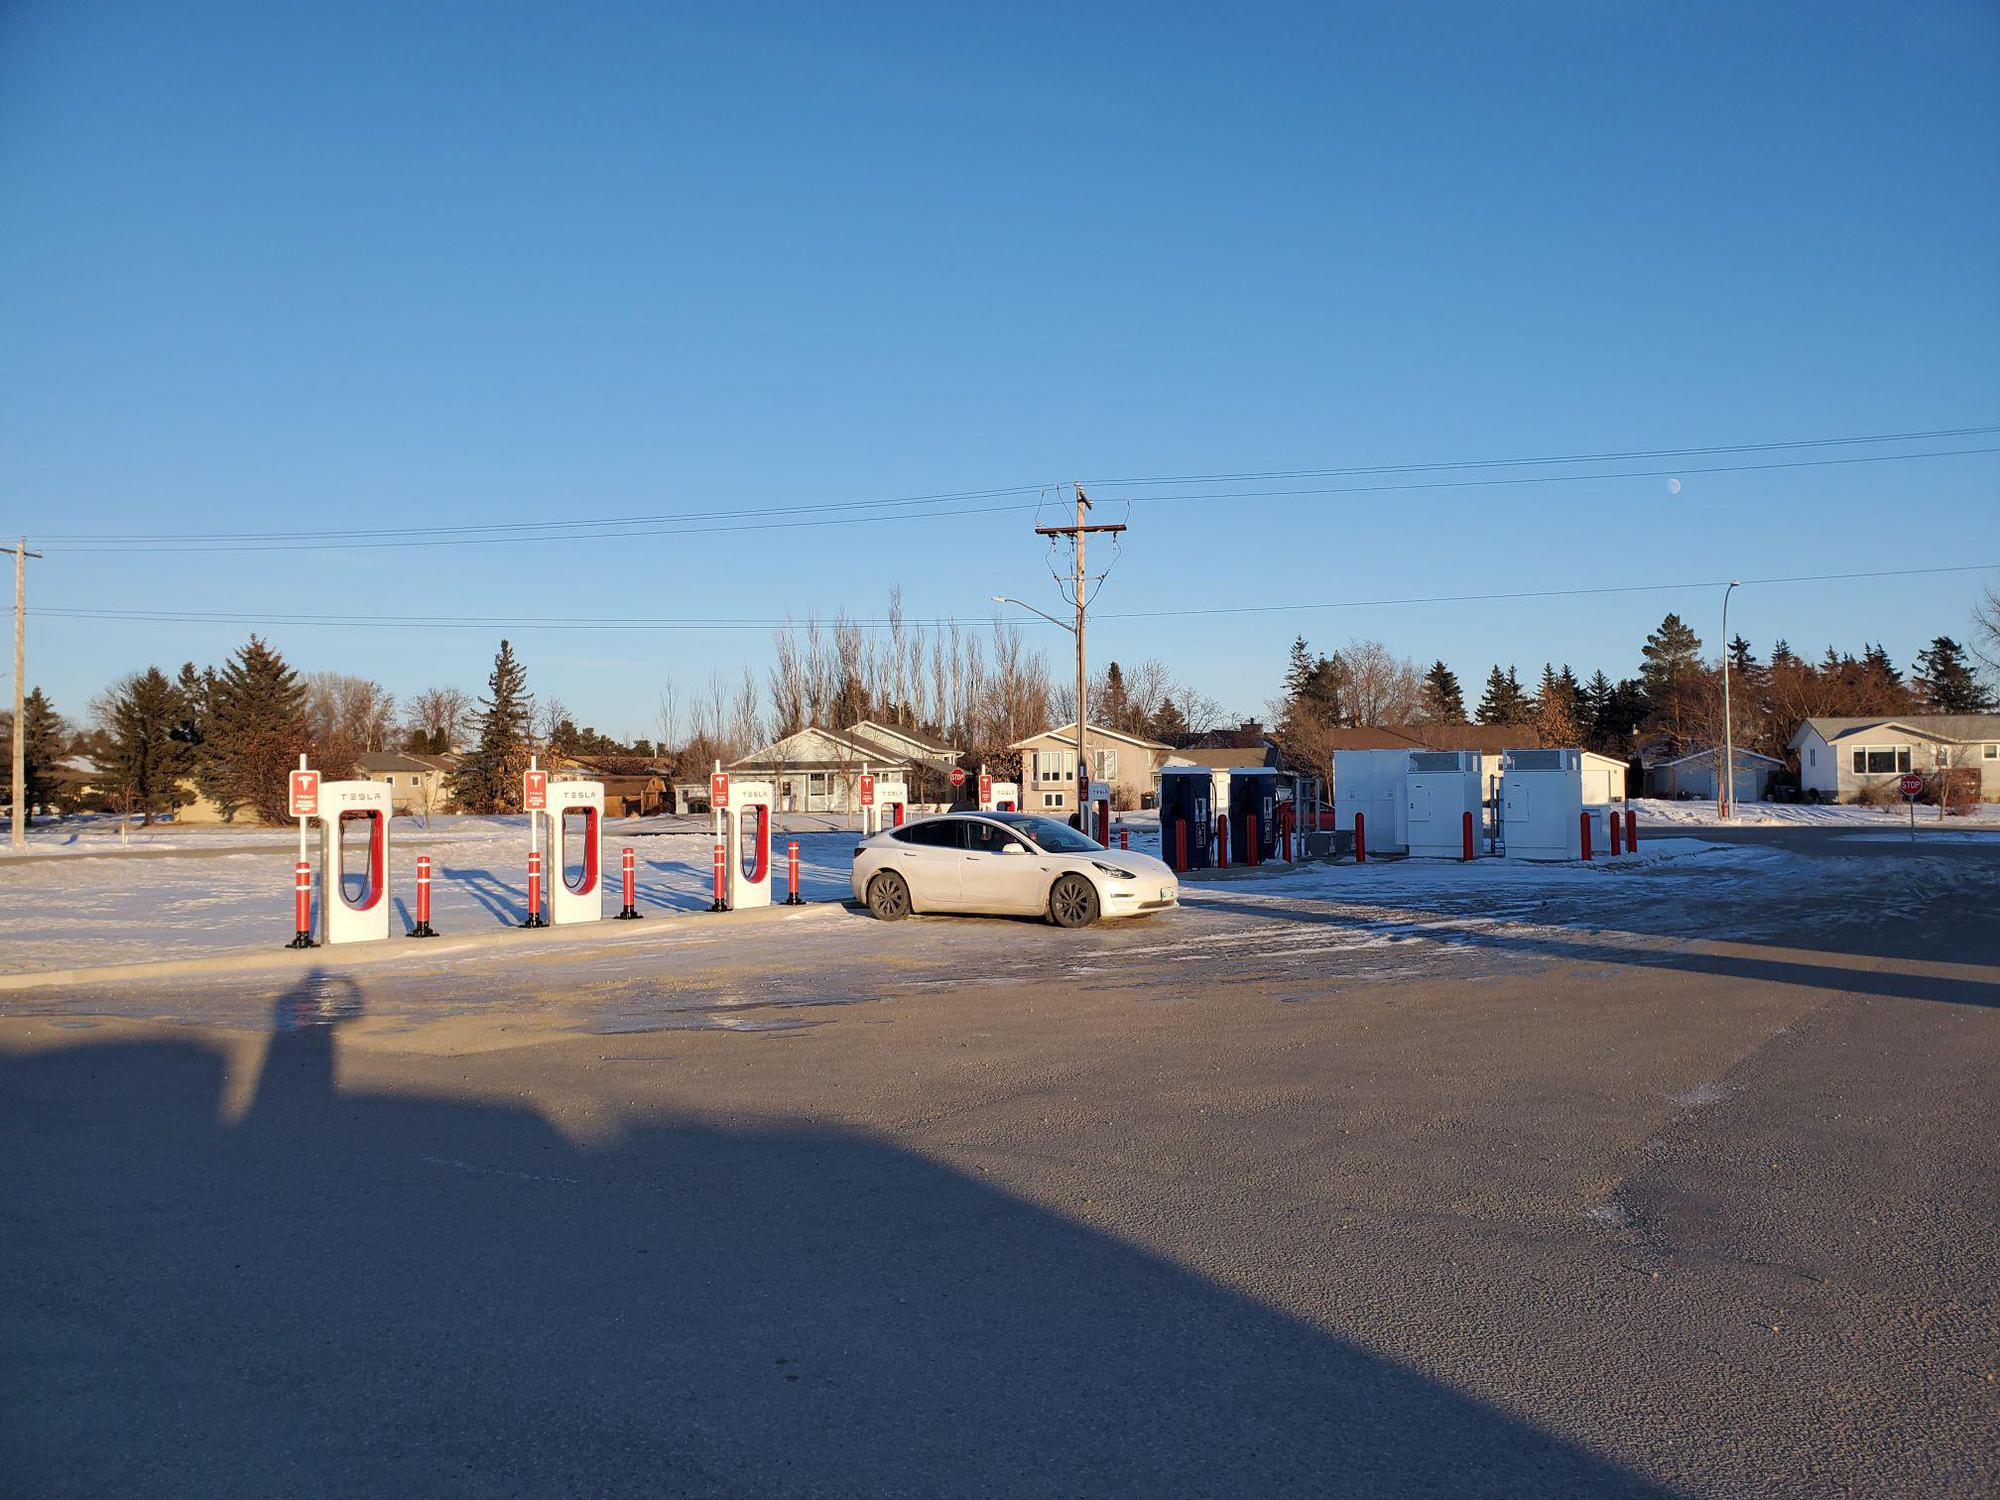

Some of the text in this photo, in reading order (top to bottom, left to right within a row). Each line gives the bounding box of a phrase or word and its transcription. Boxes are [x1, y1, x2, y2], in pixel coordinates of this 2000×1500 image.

[1902, 780, 1921, 789] STOP
[340, 792, 382, 801] TESLA
[563, 791, 597, 799] TESLA
